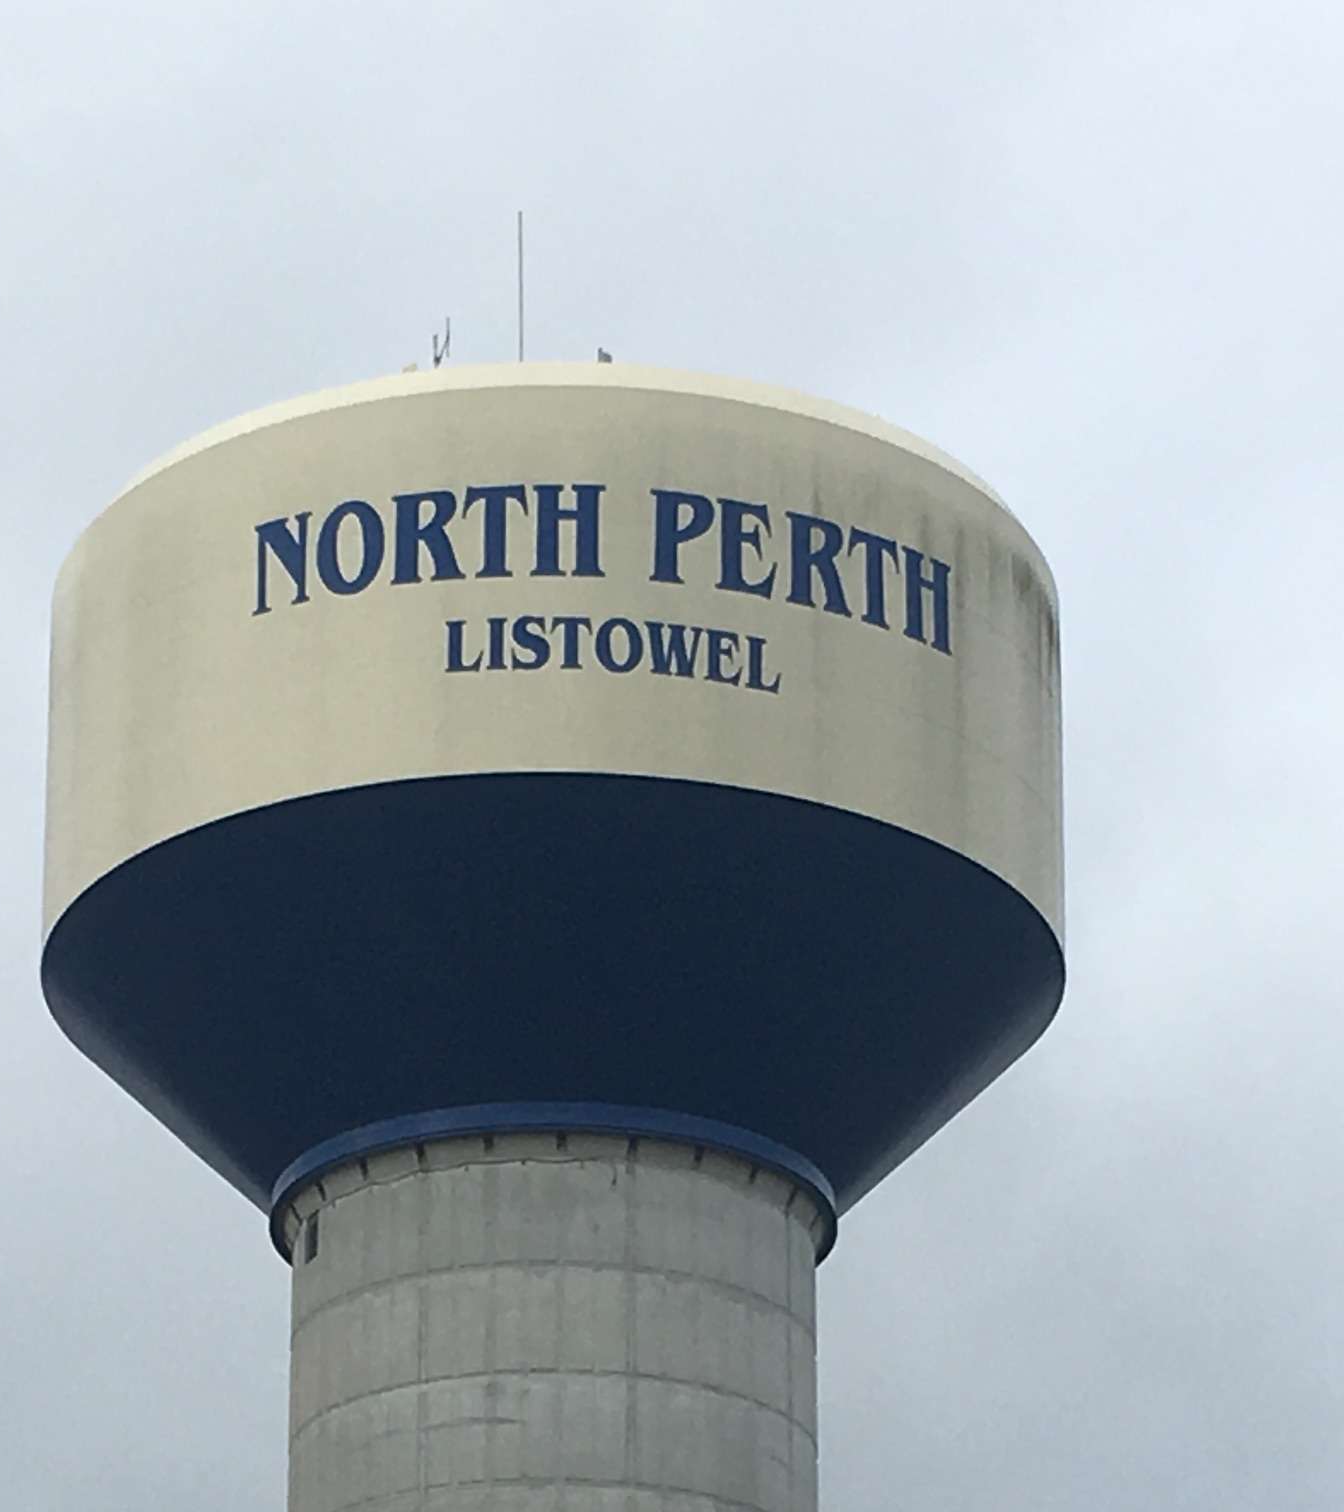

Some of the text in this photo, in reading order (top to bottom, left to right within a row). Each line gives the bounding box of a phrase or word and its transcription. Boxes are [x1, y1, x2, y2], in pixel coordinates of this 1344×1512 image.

[252, 483, 953, 657] NORTH PERTH
[444, 615, 782, 695] LISTOWEL
